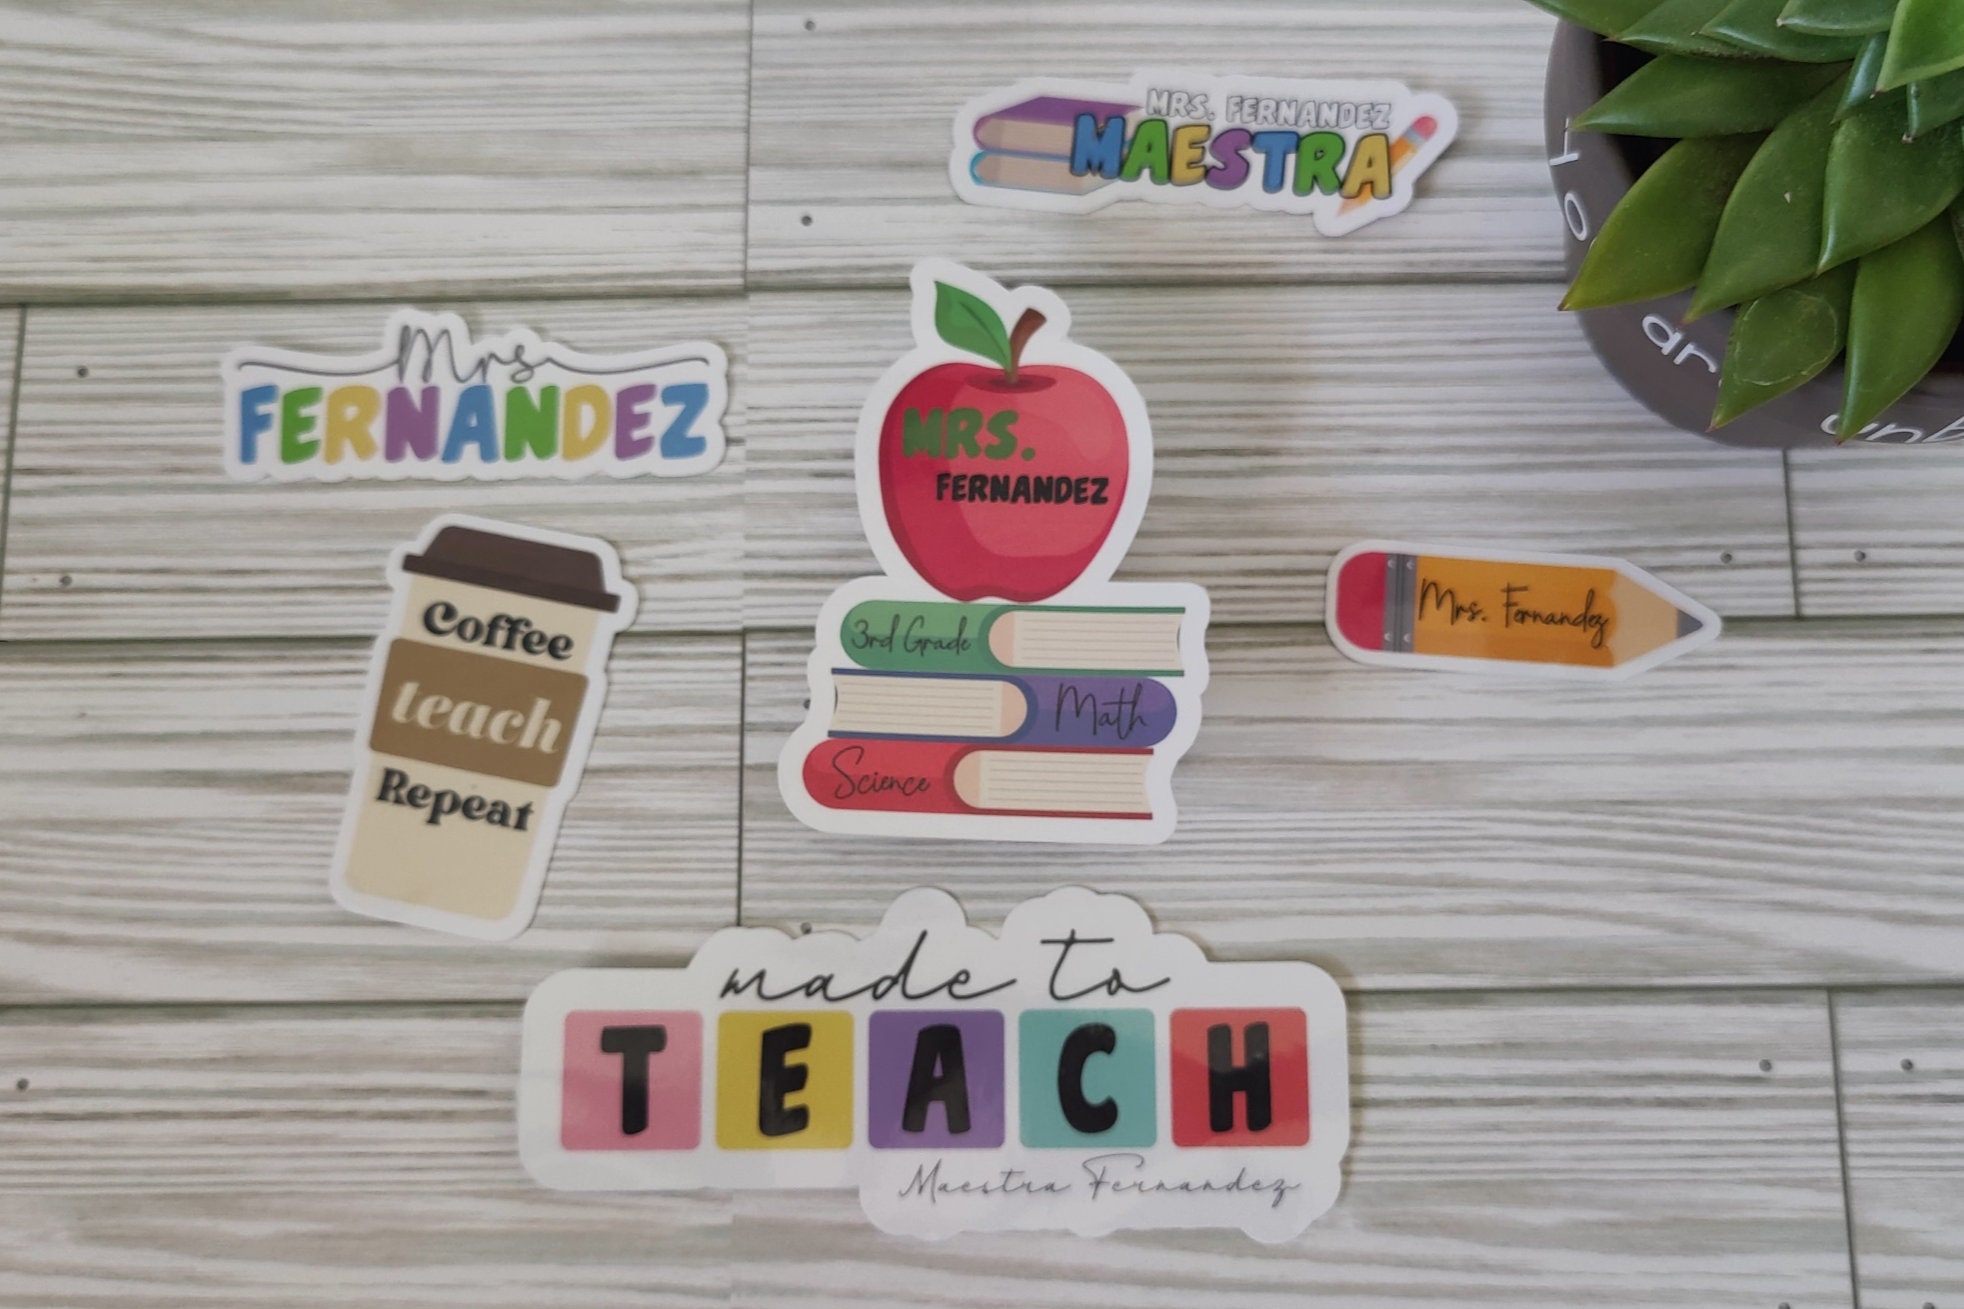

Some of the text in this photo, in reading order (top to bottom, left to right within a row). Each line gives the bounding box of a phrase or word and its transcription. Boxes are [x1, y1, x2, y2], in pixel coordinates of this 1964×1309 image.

[1146, 89, 1392, 130] MRS. FERNANDEZ
[1070, 112, 1393, 200] MAESTRA
[239, 382, 710, 465] FERNANDEZ
[903, 406, 1036, 461] MRS.
[936, 473, 1109, 506] FERNANDEZ
[422, 600, 575, 661] Coffee
[851, 614, 971, 656] 3rd Grade
[1418, 577, 1609, 649] Mrs. Fernandez
[391, 680, 563, 755] teach
[1055, 682, 1149, 740] Math
[375, 767, 534, 832] Repeat
[832, 745, 930, 799] Science
[719, 927, 1172, 1003] made to
[600, 1019, 1273, 1137] TEACH
[898, 1152, 1303, 1208] Maestra Fernandez
